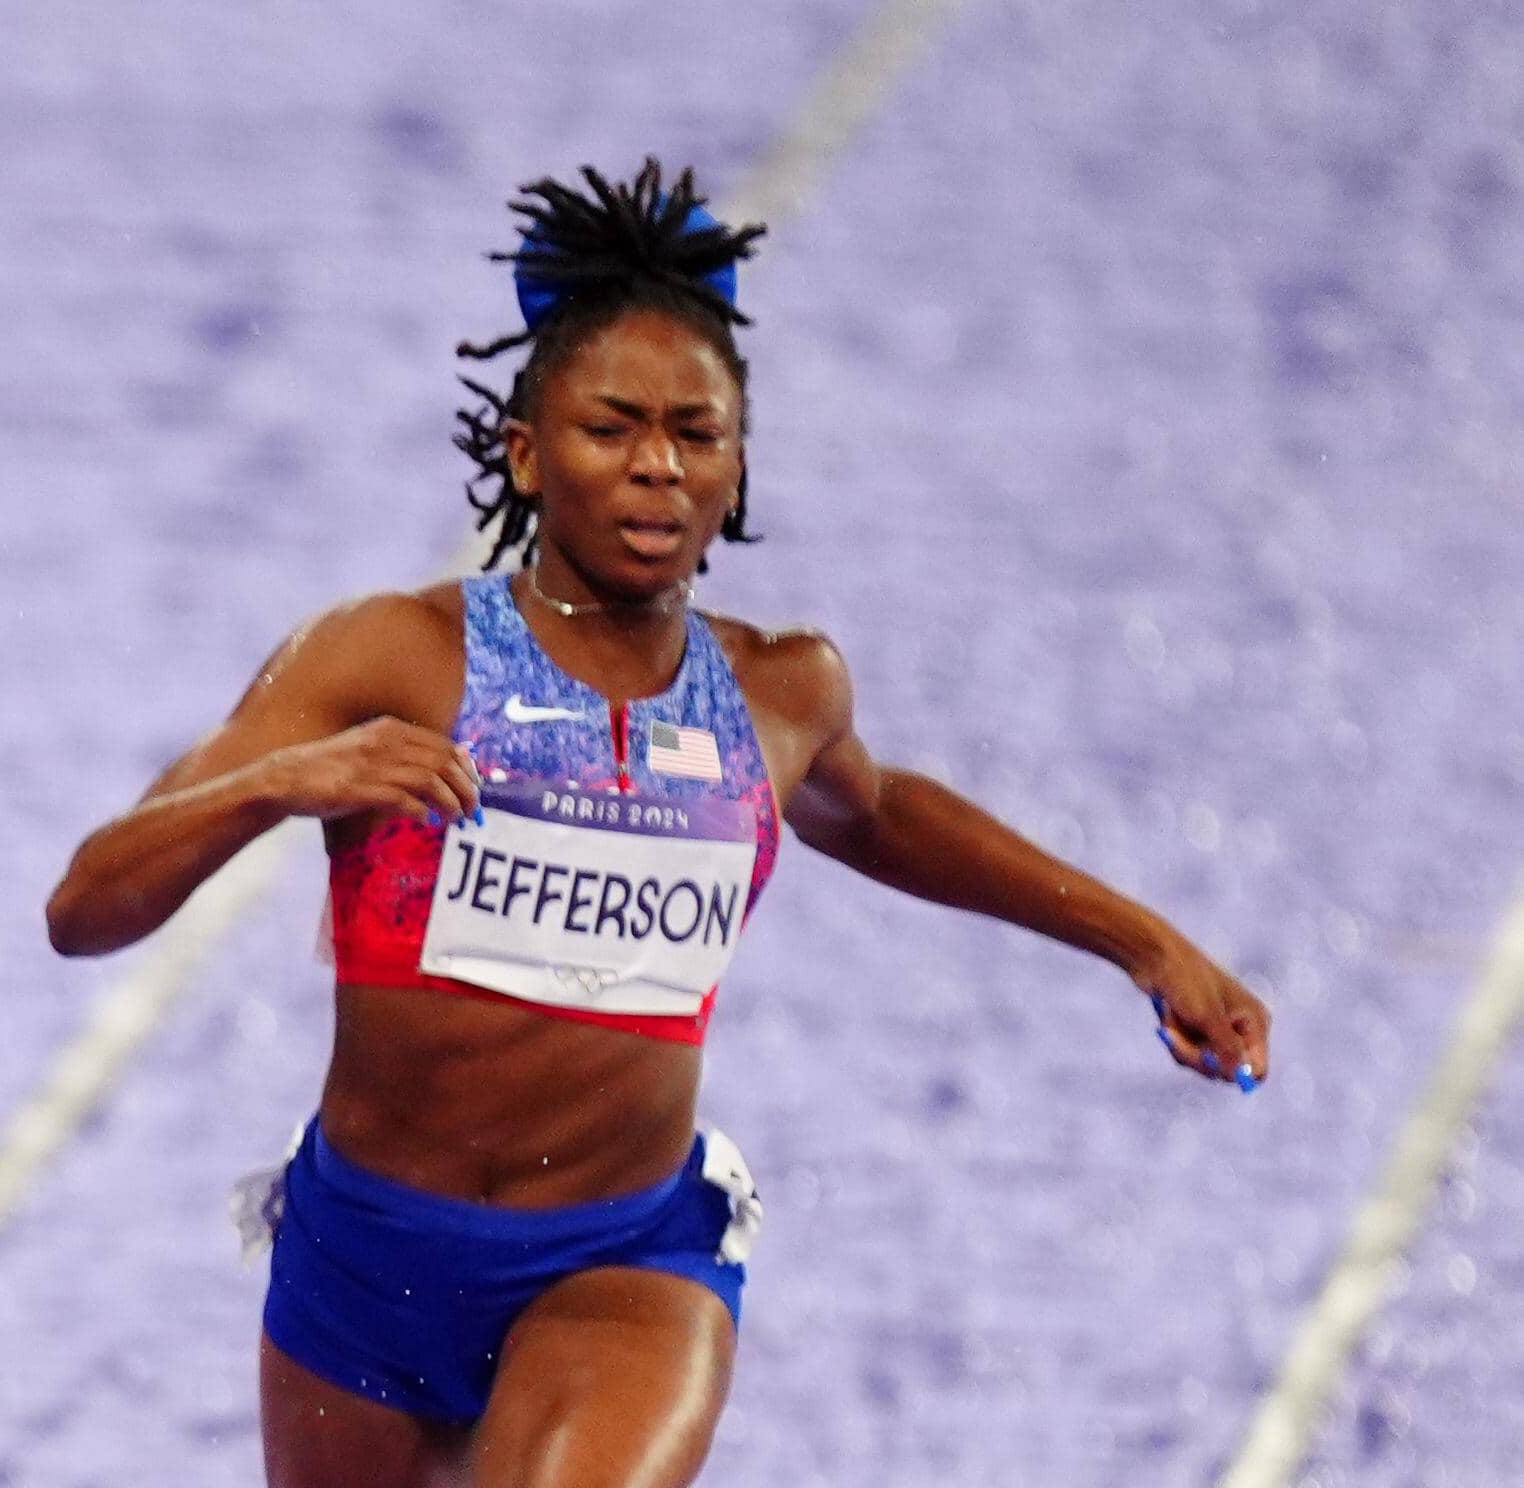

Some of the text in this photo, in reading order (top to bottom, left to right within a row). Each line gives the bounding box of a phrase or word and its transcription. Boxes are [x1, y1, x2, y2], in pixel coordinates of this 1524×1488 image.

[541, 791, 689, 831] PARIS 2024
[447, 840, 740, 948] JEFFERSON
